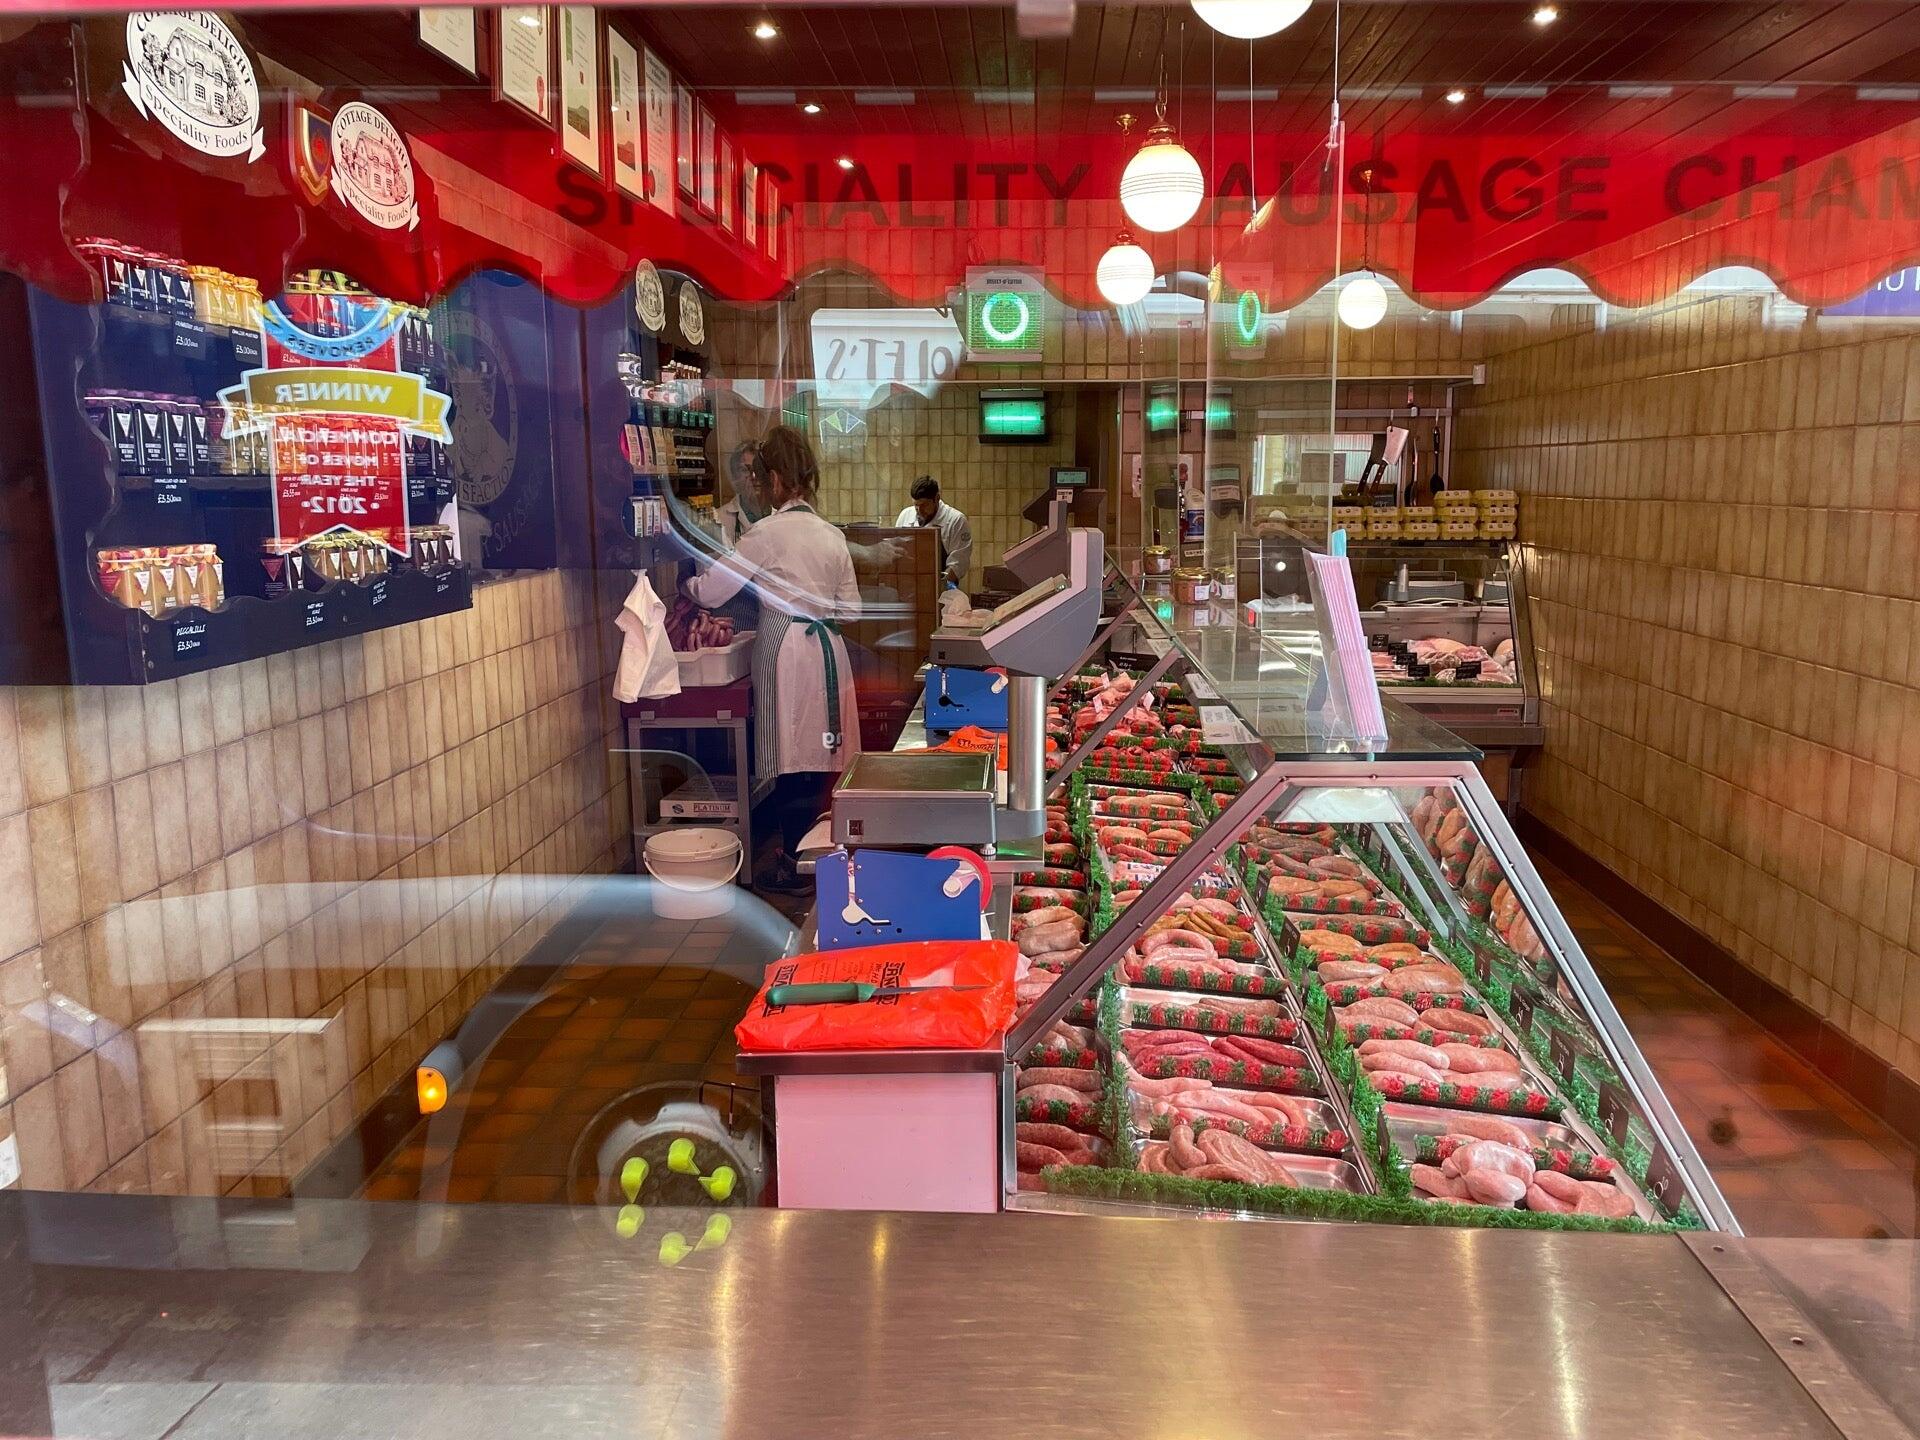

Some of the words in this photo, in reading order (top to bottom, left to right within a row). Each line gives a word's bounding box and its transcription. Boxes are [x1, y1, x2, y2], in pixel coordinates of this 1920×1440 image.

[200, 13, 252, 86] DELIGHT
[145, 84, 210, 148] Speciality
[215, 130, 248, 149] Foods
[336, 109, 372, 138] COTTAGE
[343, 179, 385, 223] Speciality
[387, 208, 409, 222] Foods
[693, 802, 731, 812] PLATINUM
